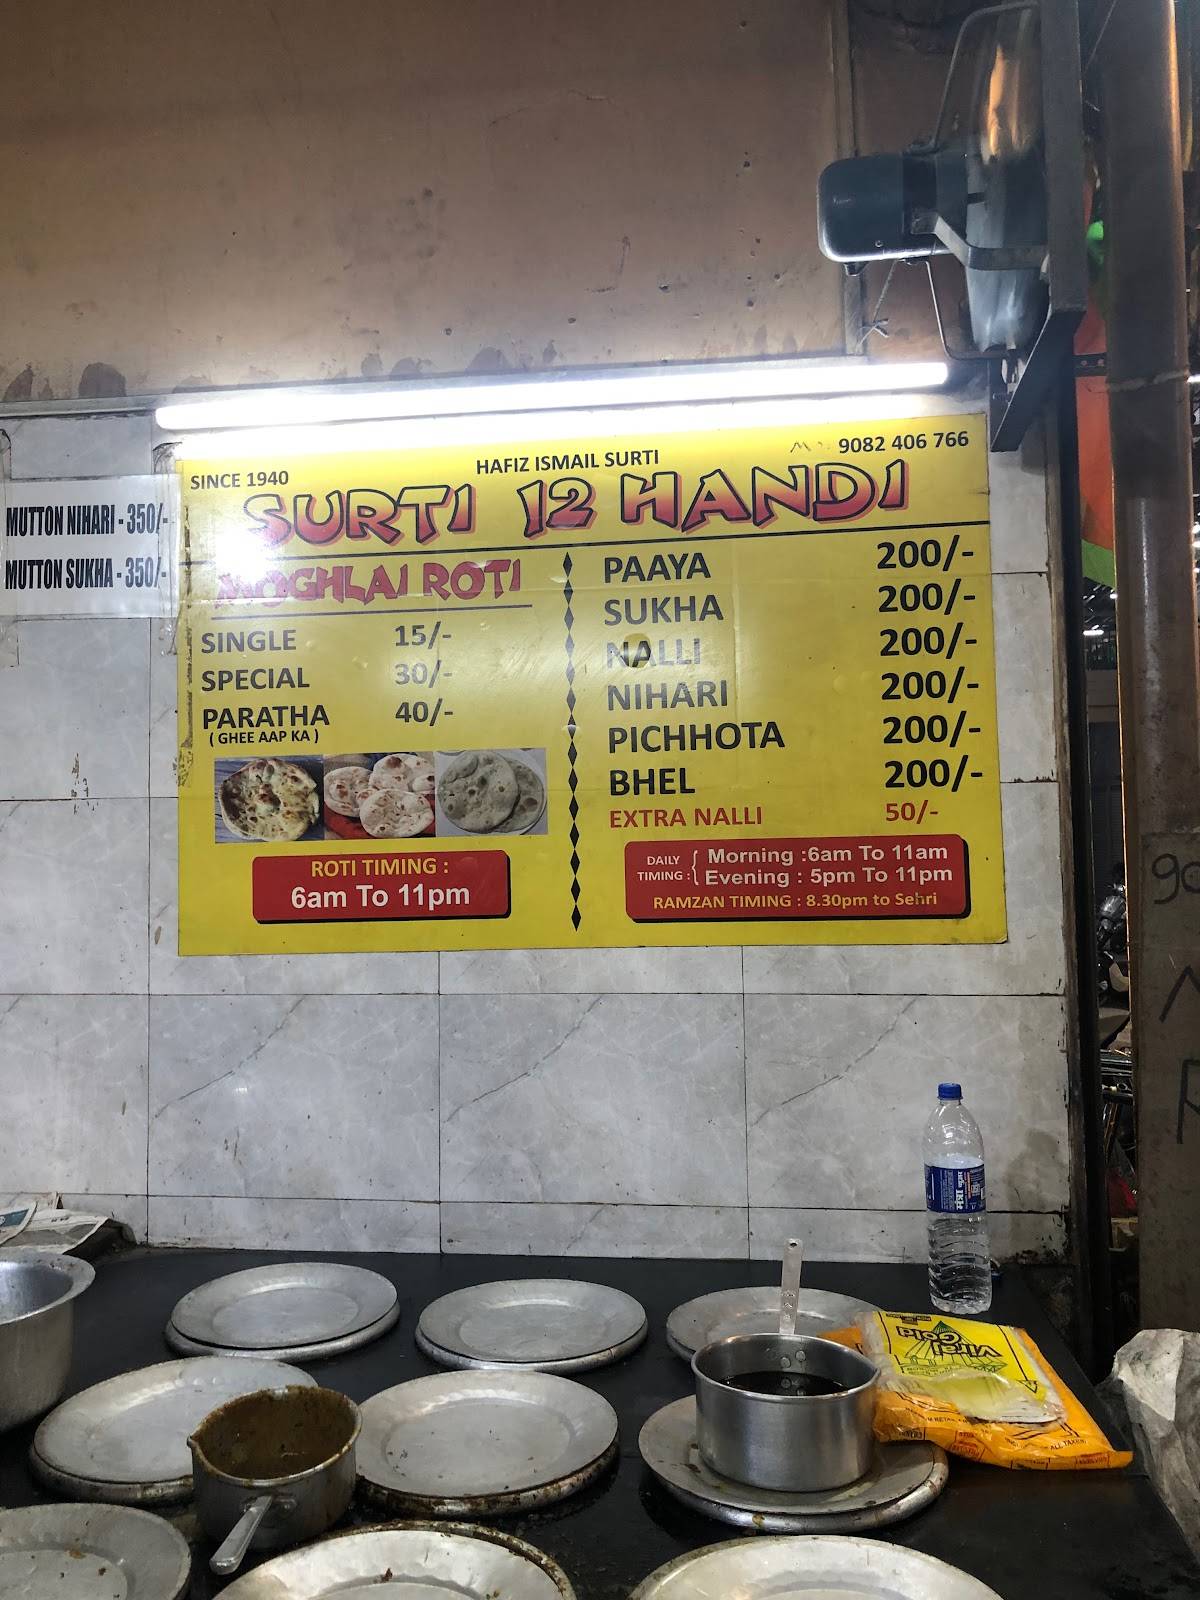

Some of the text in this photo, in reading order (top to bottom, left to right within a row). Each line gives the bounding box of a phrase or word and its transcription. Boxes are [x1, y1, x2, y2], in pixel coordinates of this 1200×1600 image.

[838, 436, 886, 454] 9082
[891, 433, 928, 450] 406
[933, 430, 969, 448] 766
[476, 449, 659, 474] HAFIZ ISMAIL SURTI
[190, 470, 289, 490] SINCE 1940
[5, 505, 64, 536] MUTTON
[67, 504, 116, 535] NIHARI
[126, 502, 169, 534] 350/-
[243, 459, 909, 547] SURTI 12 HANDI
[5, 559, 63, 590] MUTTON
[66, 558, 114, 589] SUKHA
[125, 556, 167, 588] 350/-
[603, 534, 975, 583] PAAYA 200/-
[423, 559, 521, 600] ROTI
[603, 578, 976, 626] SUKHA 200/-
[201, 621, 452, 654] SINGLE 15/-
[605, 622, 978, 669] NALLI 200/-
[201, 660, 453, 692] SPECIAL 30/-
[607, 666, 980, 711] NIHARI 200/-
[203, 698, 454, 730] PARATHA 40/-
[258, 730, 287, 744] AAP
[608, 710, 981, 754] PICHHOTA 200/-
[609, 754, 983, 796] BHEL 200/-
[609, 799, 939, 829] EXTRA NALLI 50/-
[310, 859, 357, 878] ROTI
[646, 855, 681, 867] DAILY
[707, 847, 794, 866] Morning
[858, 845, 885, 861] To
[891, 844, 949, 860] 11am
[705, 869, 790, 887] Evening
[809, 868, 856, 886] 5pm
[862, 867, 889, 883] To
[894, 866, 953, 884] 11pm
[290, 883, 471, 911] 6am To 11pm
[653, 895, 726, 909] RAMZAN
[729, 894, 792, 908] TIMING
[805, 893, 869, 909] 8.30pm
[872, 893, 891, 906] to
[895, 891, 938, 905] Sehri
[895, 1325, 961, 1345] Gold
